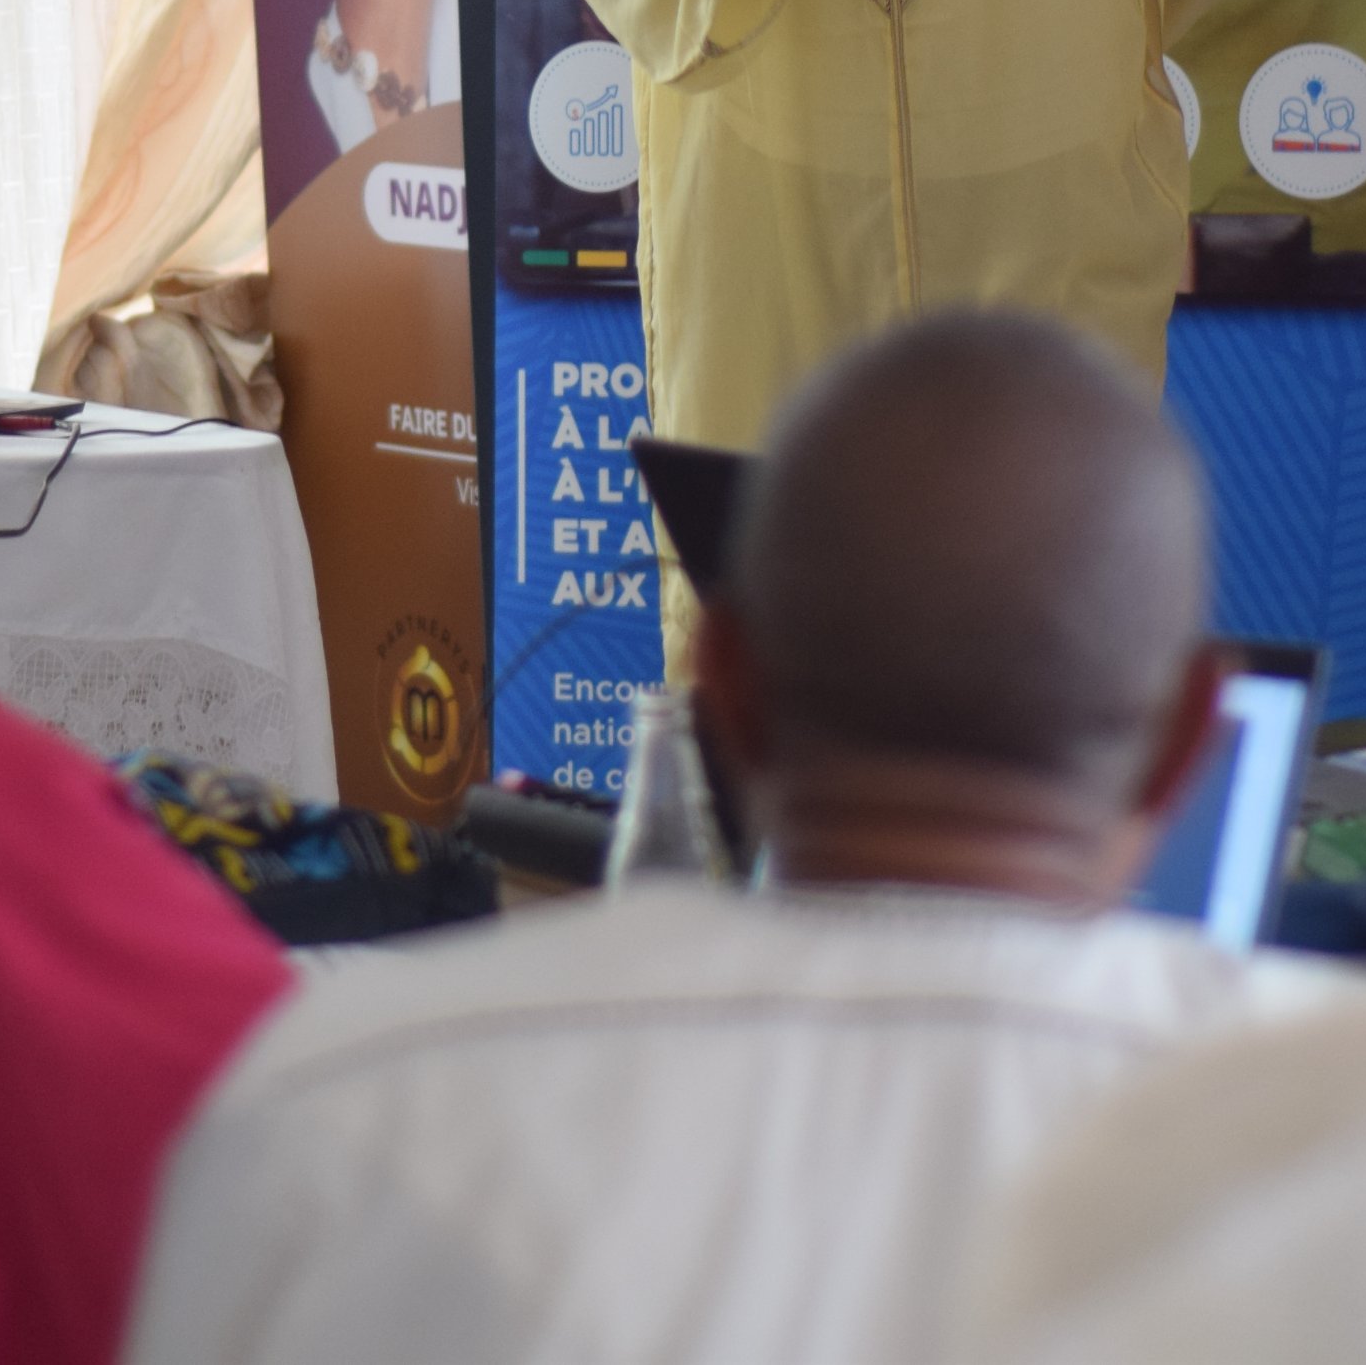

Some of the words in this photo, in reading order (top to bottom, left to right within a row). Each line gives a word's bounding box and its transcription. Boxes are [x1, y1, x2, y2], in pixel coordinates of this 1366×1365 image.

[553, 361, 646, 399] PRO
[389, 404, 448, 438] FAIRE
[551, 404, 585, 450] À
[551, 457, 585, 502] À
[553, 518, 608, 554] ET
[551, 570, 647, 608] AUX
[553, 760, 595, 790] de
